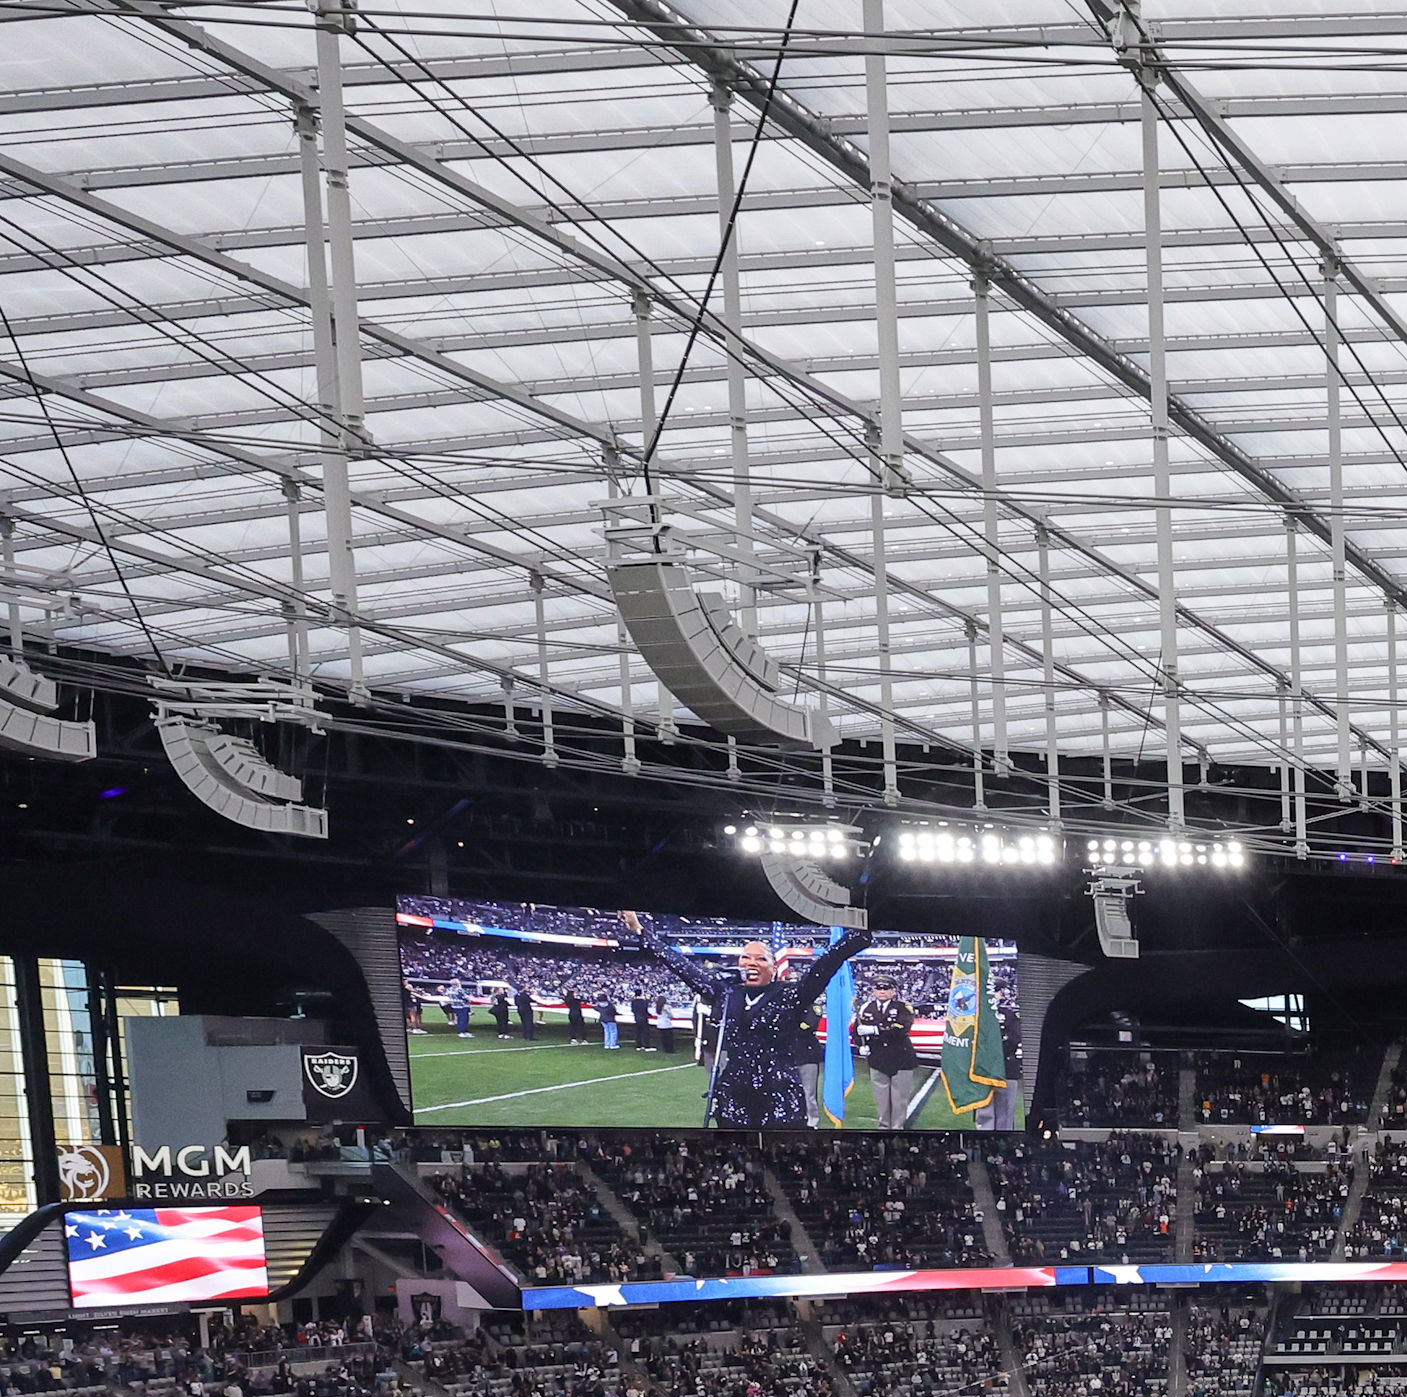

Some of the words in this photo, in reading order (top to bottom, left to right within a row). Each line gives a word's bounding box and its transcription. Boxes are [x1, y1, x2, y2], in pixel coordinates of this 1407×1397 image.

[311, 1057, 352, 1066] RAIDERS
[133, 1145, 252, 1177] MGM
[136, 1181, 254, 1199] REWARDS
